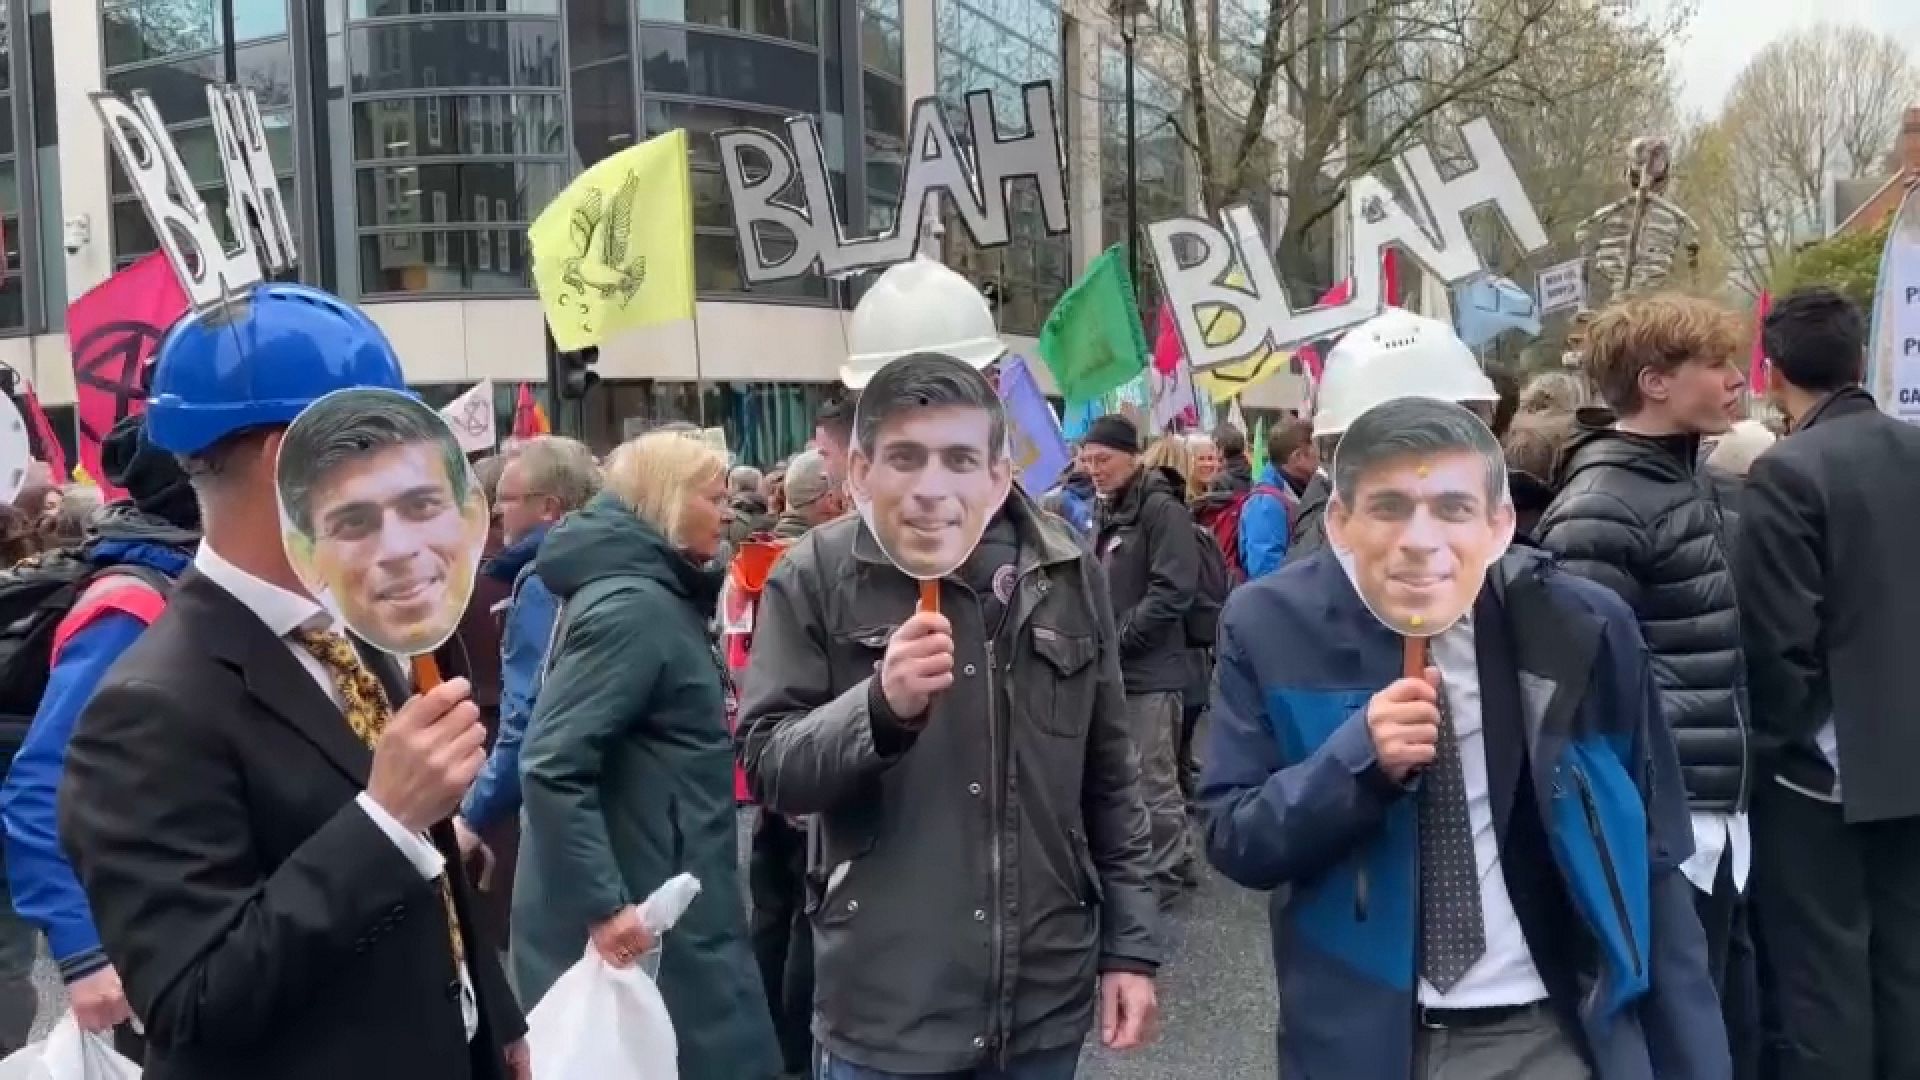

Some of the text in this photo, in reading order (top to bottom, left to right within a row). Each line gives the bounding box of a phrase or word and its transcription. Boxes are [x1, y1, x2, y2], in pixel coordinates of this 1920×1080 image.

[90, 84, 297, 307] BLAH
[711, 80, 1070, 289] BLAH
[1147, 118, 1549, 371] BLAH
